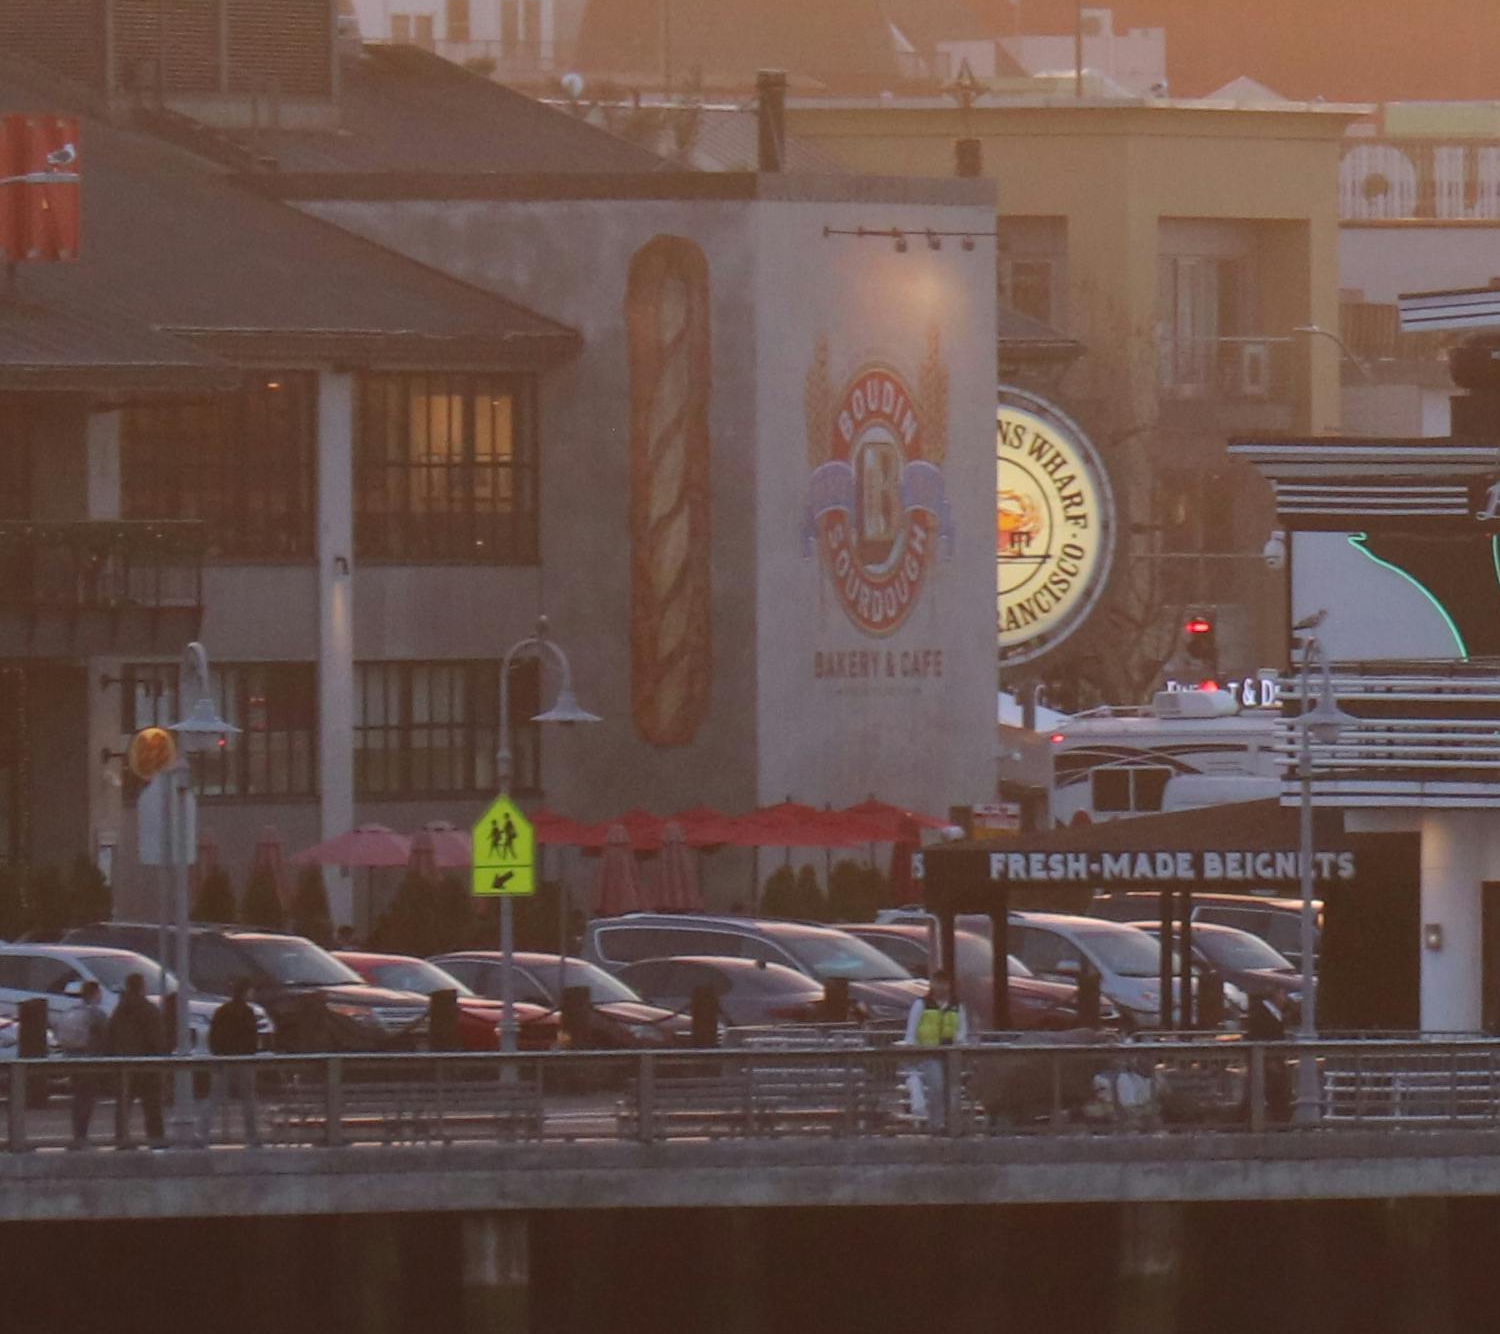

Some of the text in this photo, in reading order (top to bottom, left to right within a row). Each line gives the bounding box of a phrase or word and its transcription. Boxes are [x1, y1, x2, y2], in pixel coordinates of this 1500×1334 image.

[838, 379, 918, 444] BOUDIN
[1026, 432, 1088, 530] WHARF
[828, 523, 927, 623] SOURDOUGH
[997, 542, 1085, 634] ANCISCO
[814, 650, 879, 679] BAKERY
[901, 650, 944, 678] CAFE
[989, 852, 1195, 880] FRESH-MADE
